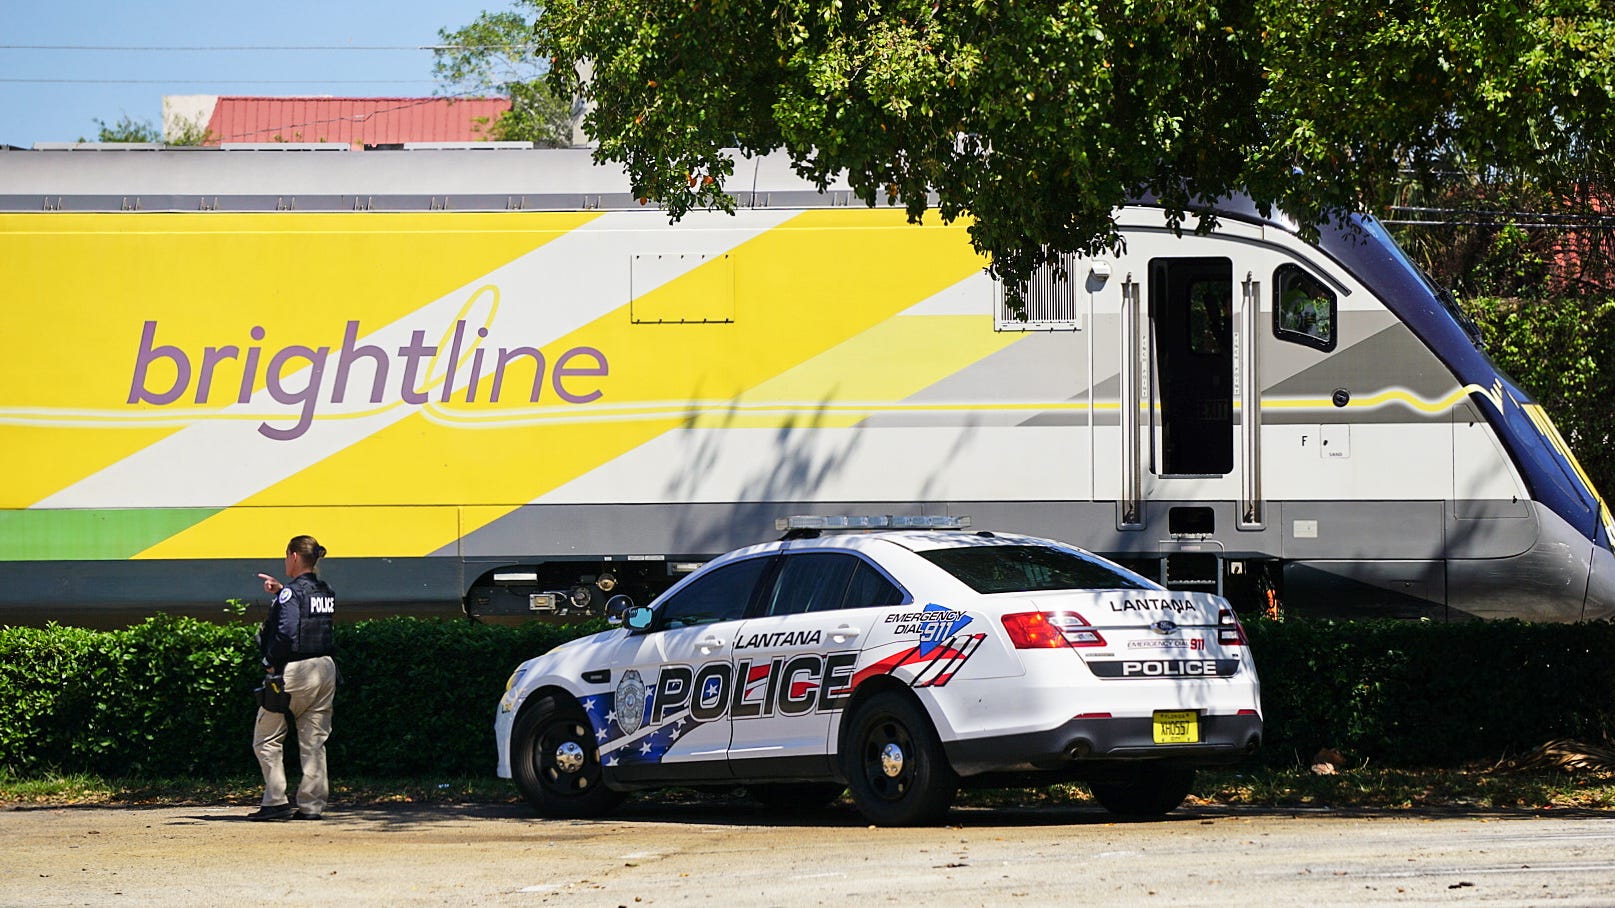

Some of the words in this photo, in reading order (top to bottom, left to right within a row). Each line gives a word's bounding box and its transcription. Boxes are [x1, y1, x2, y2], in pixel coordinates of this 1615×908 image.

[127, 320, 609, 441] brightline
[1301, 435, 1308, 446] F
[310, 596, 335, 613] POLICE
[1110, 598, 1196, 612] LANTANA
[885, 610, 968, 623] EMERGENCY
[894, 623, 923, 634] DIAL
[920, 621, 954, 642] 911
[735, 630, 821, 650] LANTANA
[1127, 640, 1172, 648] EMERGENCY
[1175, 640, 1189, 648] DIAL
[1190, 638, 1205, 650] 911
[1122, 661, 1217, 676] POLICE
[650, 650, 861, 726] POLICE
